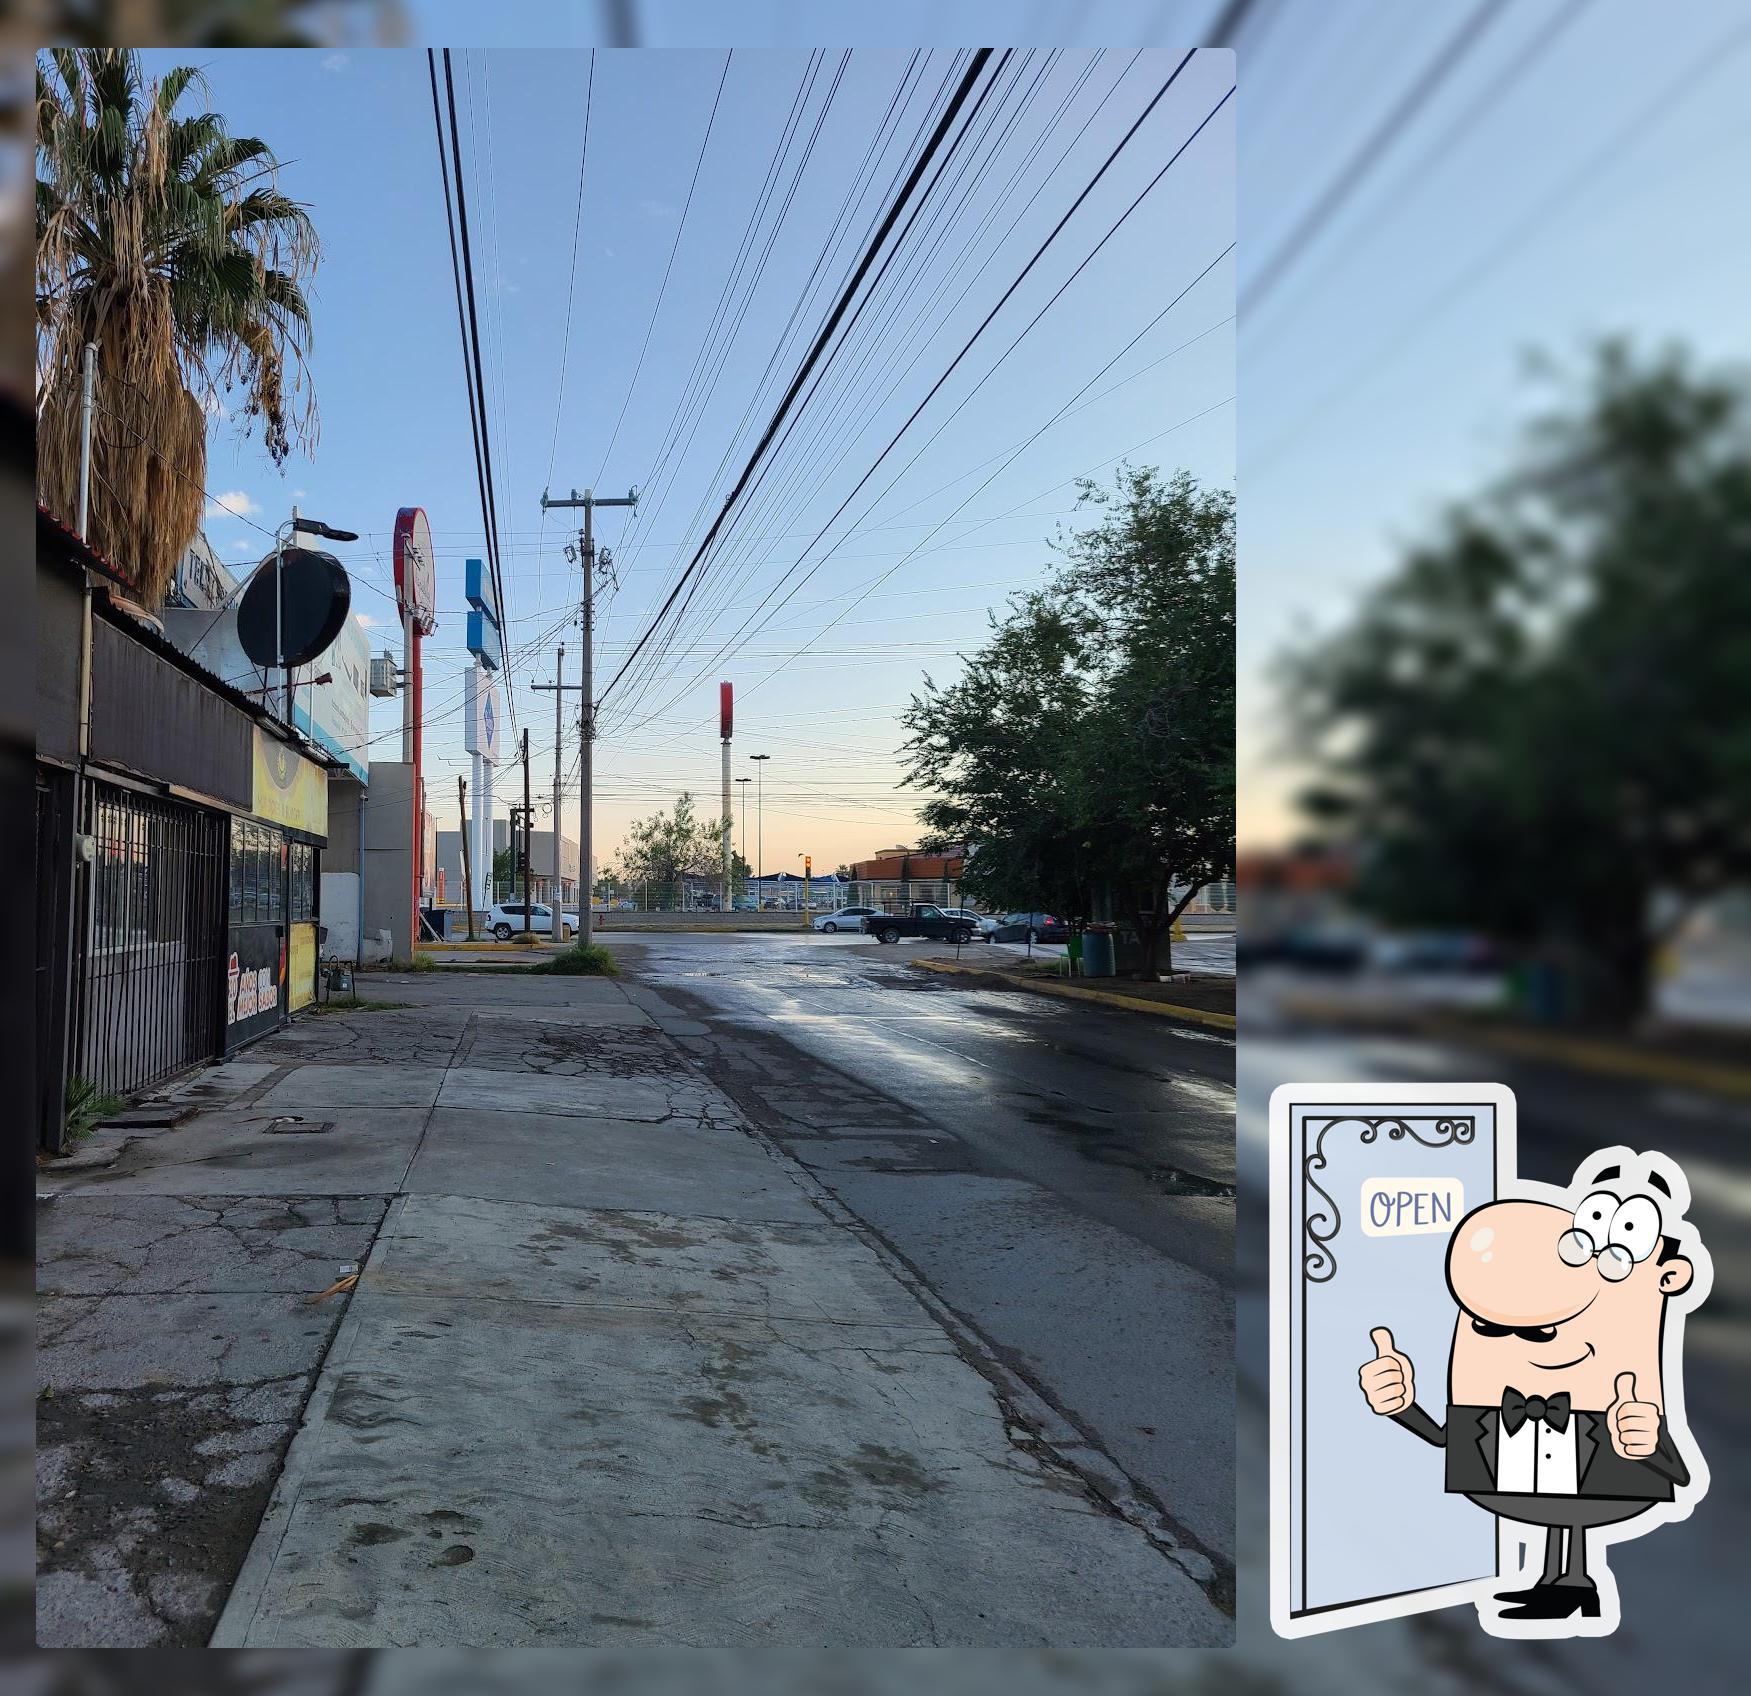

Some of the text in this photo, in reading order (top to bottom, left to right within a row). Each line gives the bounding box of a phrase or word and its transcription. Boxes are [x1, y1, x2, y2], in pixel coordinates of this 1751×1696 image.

[240, 968, 257, 993] AÑOS
[239, 994, 257, 1017] MEJOR
[258, 987, 277, 1011] SABOR
